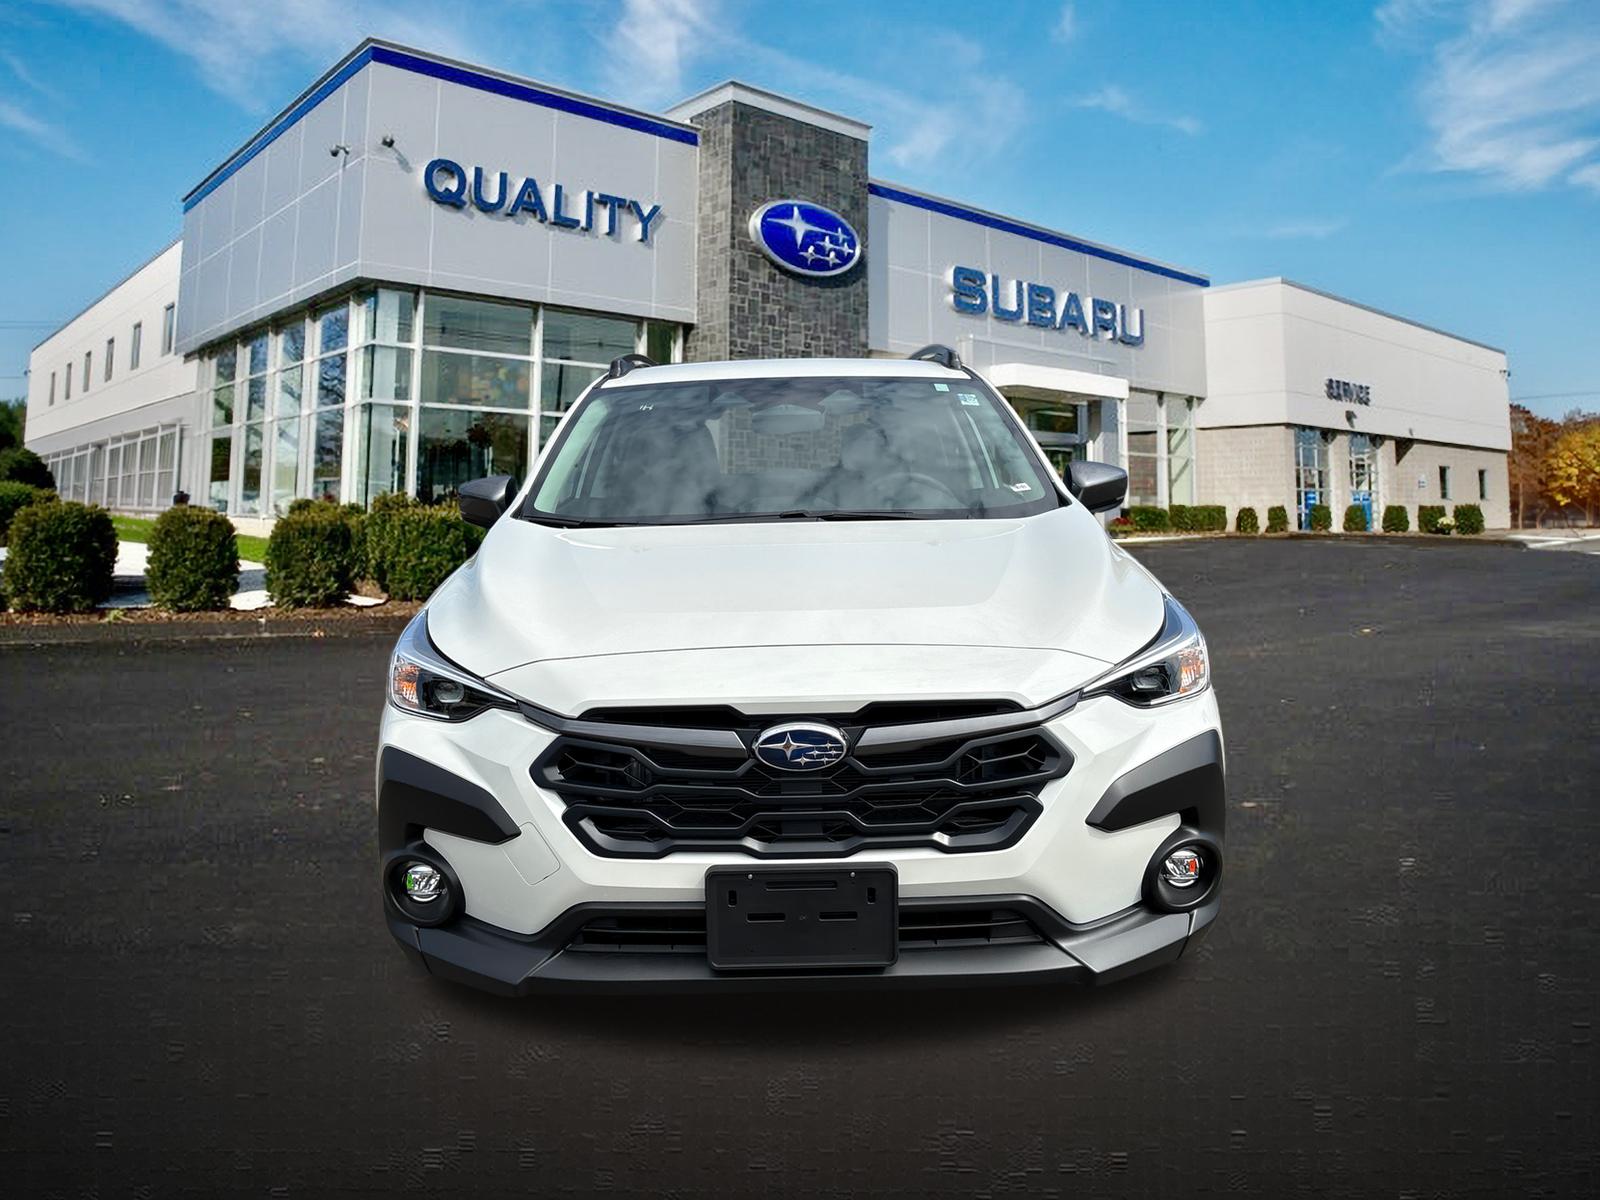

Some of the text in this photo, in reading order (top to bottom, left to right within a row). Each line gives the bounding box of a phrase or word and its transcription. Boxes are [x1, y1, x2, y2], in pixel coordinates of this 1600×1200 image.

[424, 158, 661, 242] QUALITY
[952, 265, 1145, 346] SUBARU
[1325, 378, 1371, 406] SERVICE
